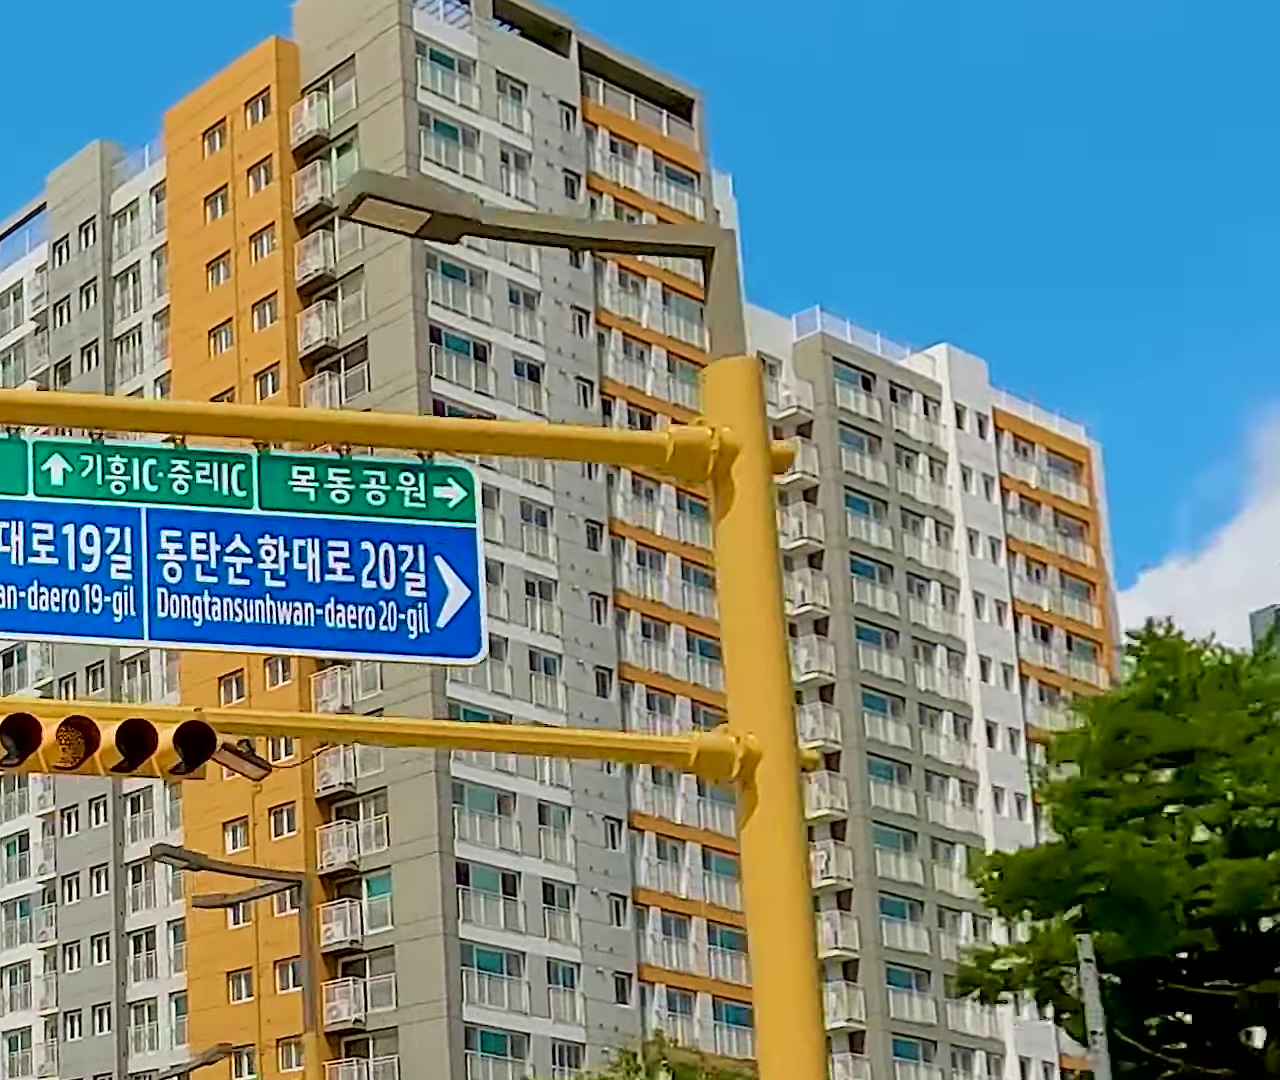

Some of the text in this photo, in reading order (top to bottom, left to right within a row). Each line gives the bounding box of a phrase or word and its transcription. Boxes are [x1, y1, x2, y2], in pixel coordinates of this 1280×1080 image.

[78, 452, 248, 499] 기흥IC·중리IC
[287, 463, 428, 509] 목동공원
[156, 529, 428, 598] 동탄순환대로20길
[83, 583, 137, 623] 19-gil
[156, 586, 431, 640] Dongtansunhwan-daero 20-gil
